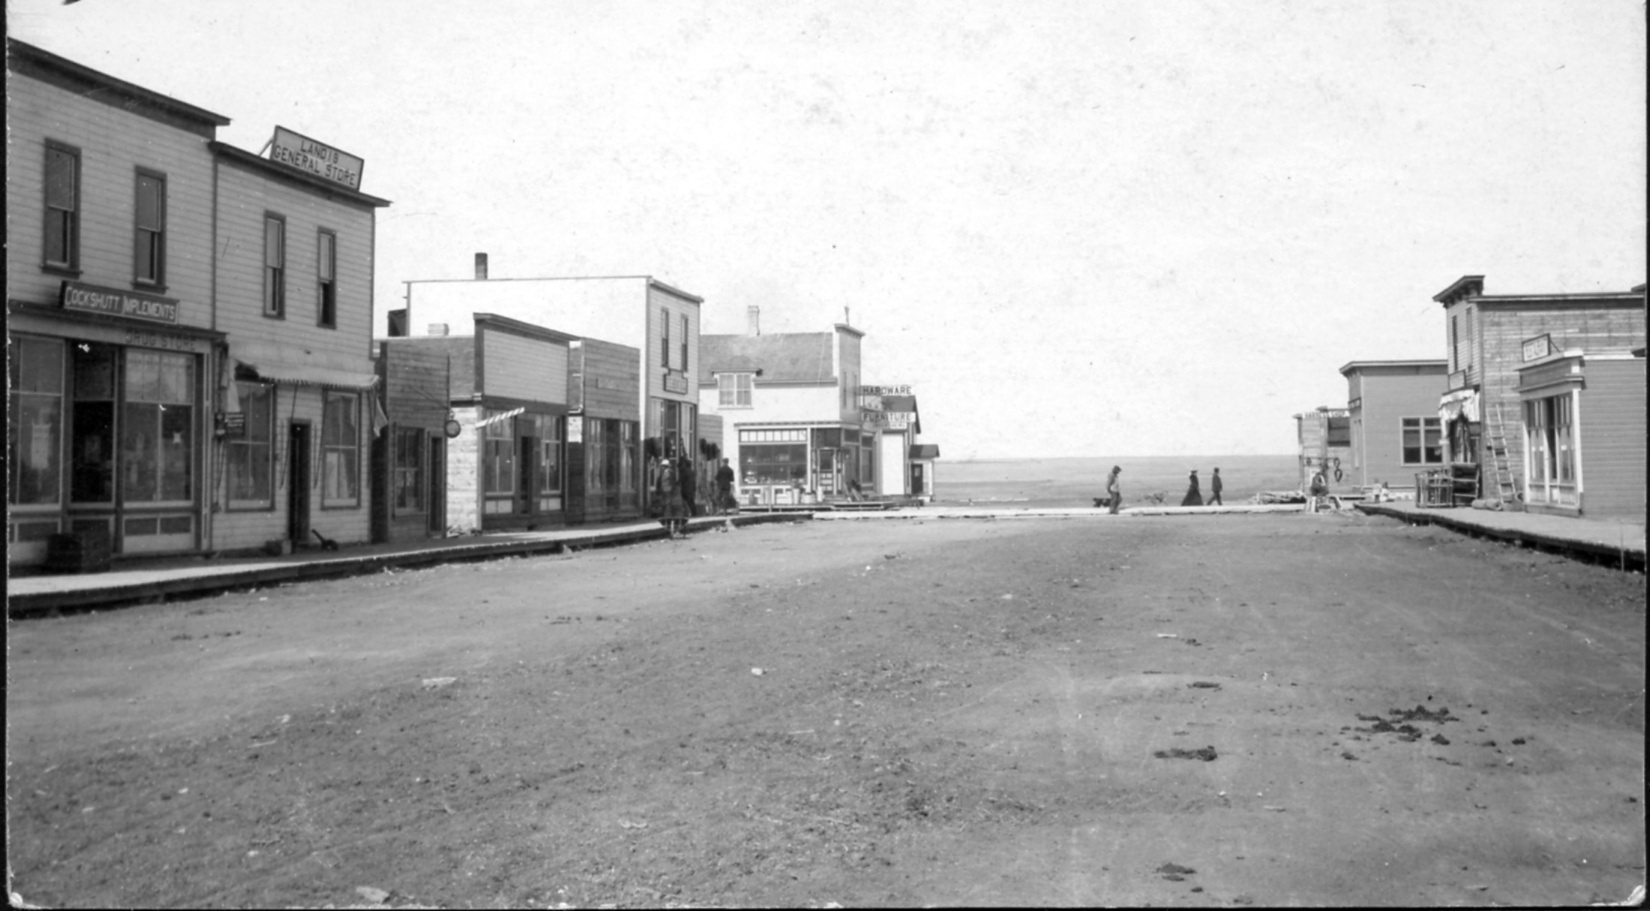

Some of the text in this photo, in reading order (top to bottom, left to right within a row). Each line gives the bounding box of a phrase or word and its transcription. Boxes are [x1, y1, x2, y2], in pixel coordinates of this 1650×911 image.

[301, 140, 339, 164] LANDIS
[274, 145, 356, 186] GENERAL STORE
[65, 286, 176, 320] COCKSHUTT IMPLEMENTS
[126, 329, 197, 350] DRUG STORE
[863, 386, 911, 395] HARDWARE
[863, 412, 911, 421] FURNITURE
